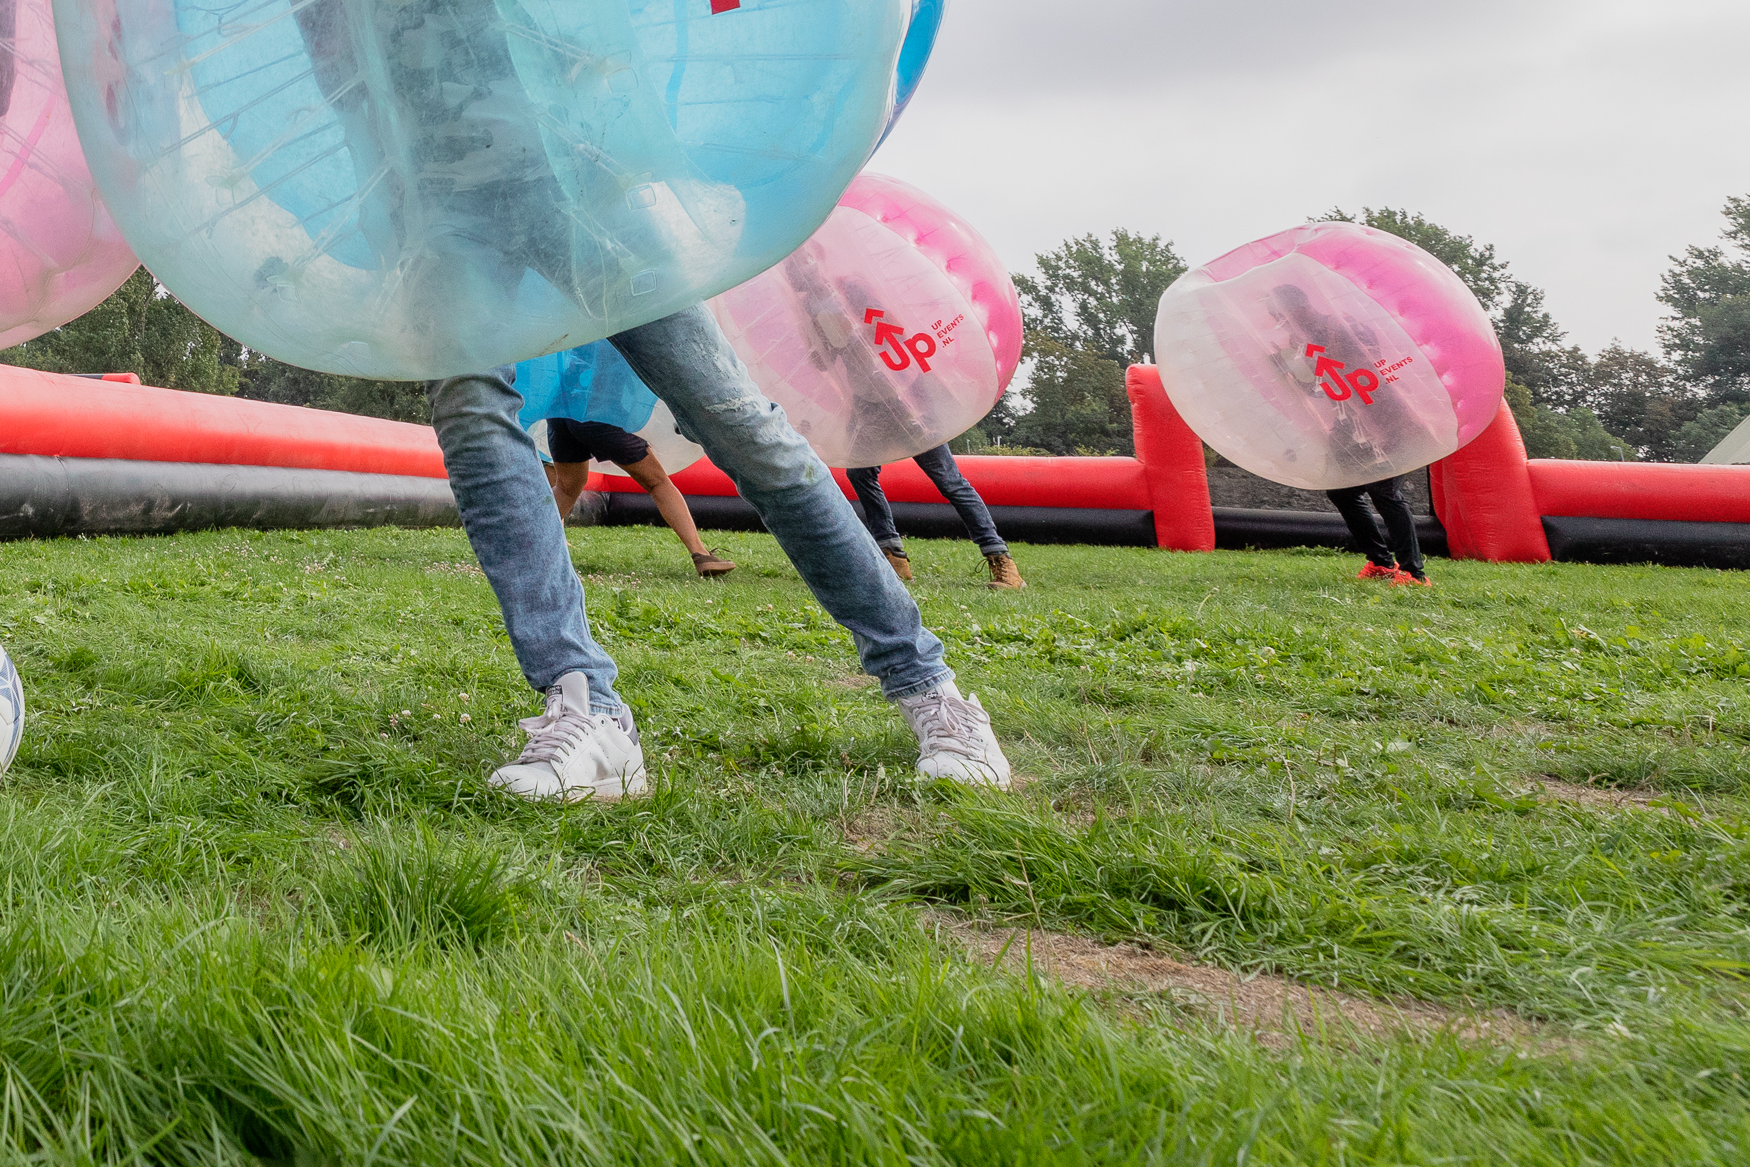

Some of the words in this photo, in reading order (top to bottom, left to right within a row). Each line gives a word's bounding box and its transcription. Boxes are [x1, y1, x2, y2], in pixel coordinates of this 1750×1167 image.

[931, 319, 943, 331] UP
[936, 314, 965, 339] EVENTS
[942, 337, 955, 348] .NL
[1374, 359, 1387, 368] UP
[1380, 356, 1413, 376] EVENTS
[1385, 374, 1399, 384] .NL
